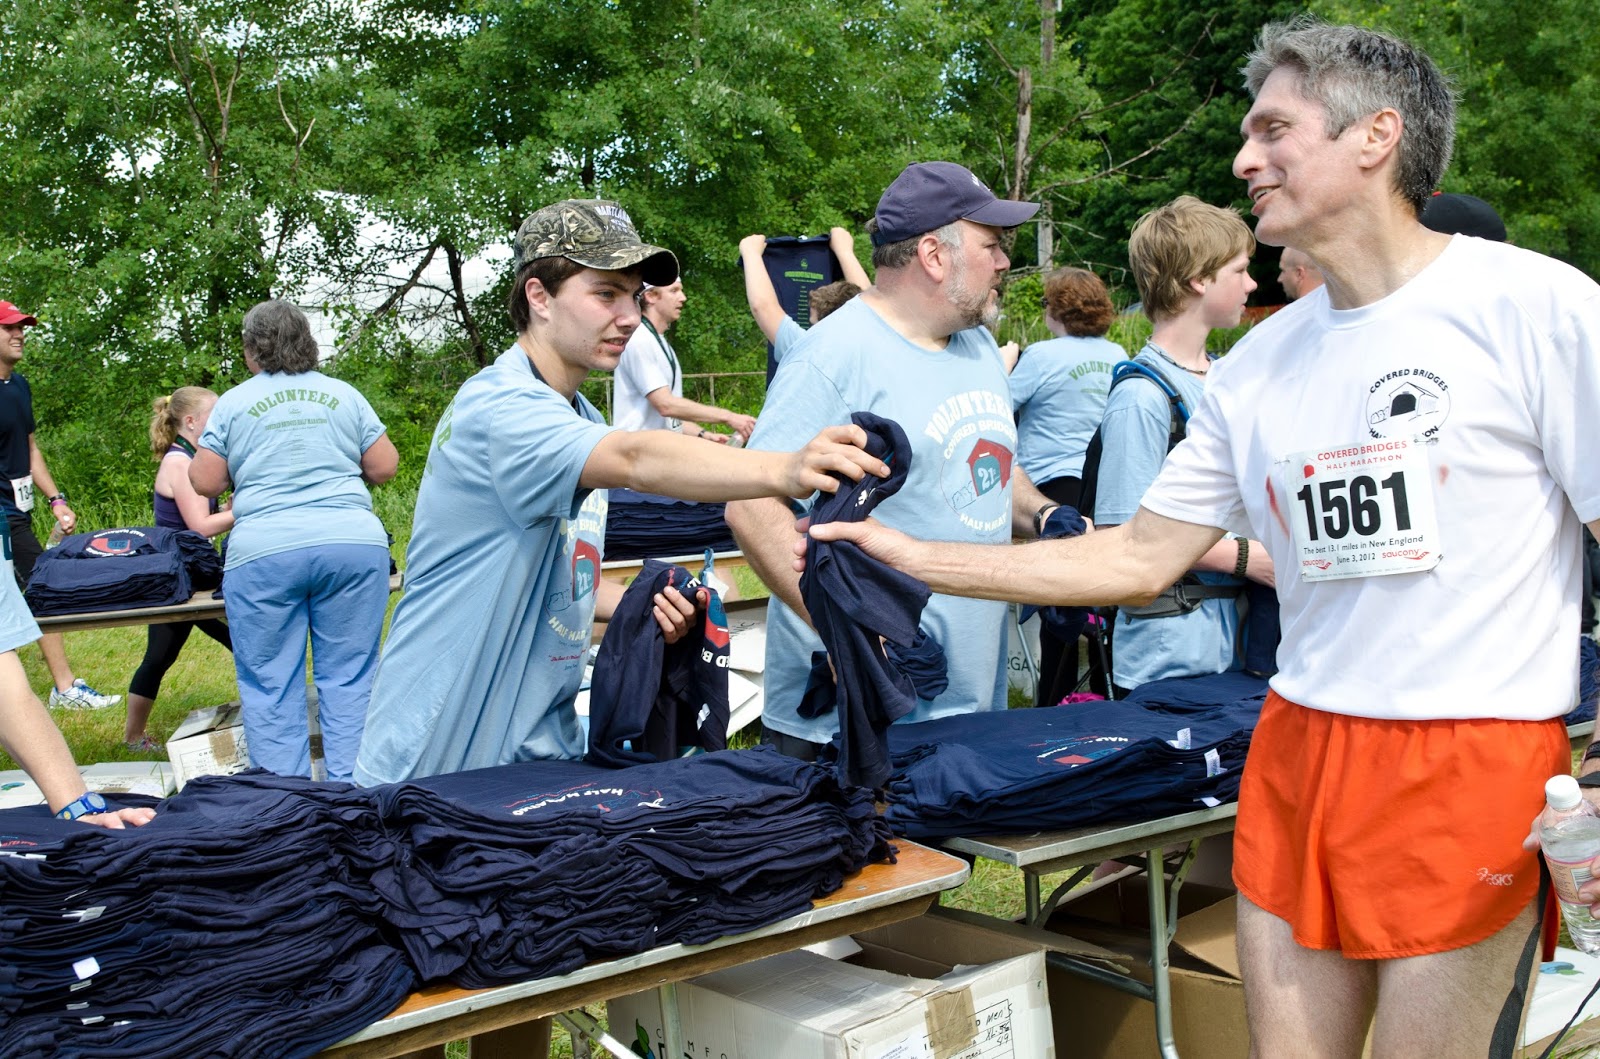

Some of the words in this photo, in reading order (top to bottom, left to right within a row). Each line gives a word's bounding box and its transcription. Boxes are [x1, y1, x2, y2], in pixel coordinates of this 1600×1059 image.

[1370, 369, 1410, 393] COVERED
[1413, 368, 1448, 391] BRIDGES
[247, 389, 340, 418] VOLUNTEER
[943, 422, 977, 460] COVERED
[1318, 448, 1359, 461] COVERED
[1360, 440, 1407, 454] BRIDGES
[1326, 460, 1347, 471] HALF
[1350, 454, 1402, 467] MARATHON
[1297, 470, 1412, 542] 1561
[960, 512, 984, 531] HALF
[1303, 547, 1315, 555] The
[1315, 546, 1326, 554] best
[1328, 544, 1339, 553] 13.1
[1342, 542, 1358, 551] miles
[1369, 539, 1386, 548] New
[1389, 535, 1424, 547] England
[1302, 558, 1325, 567] saucony
[1336, 556, 1350, 566] June
[1351, 554, 1358, 563] 3,
[1359, 553, 1376, 562] 2012
[1382, 549, 1419, 559] saucony
[548, 616, 569, 638] HALF
[568, 629, 587, 641] MAR
[584, 788, 623, 796] HALF
